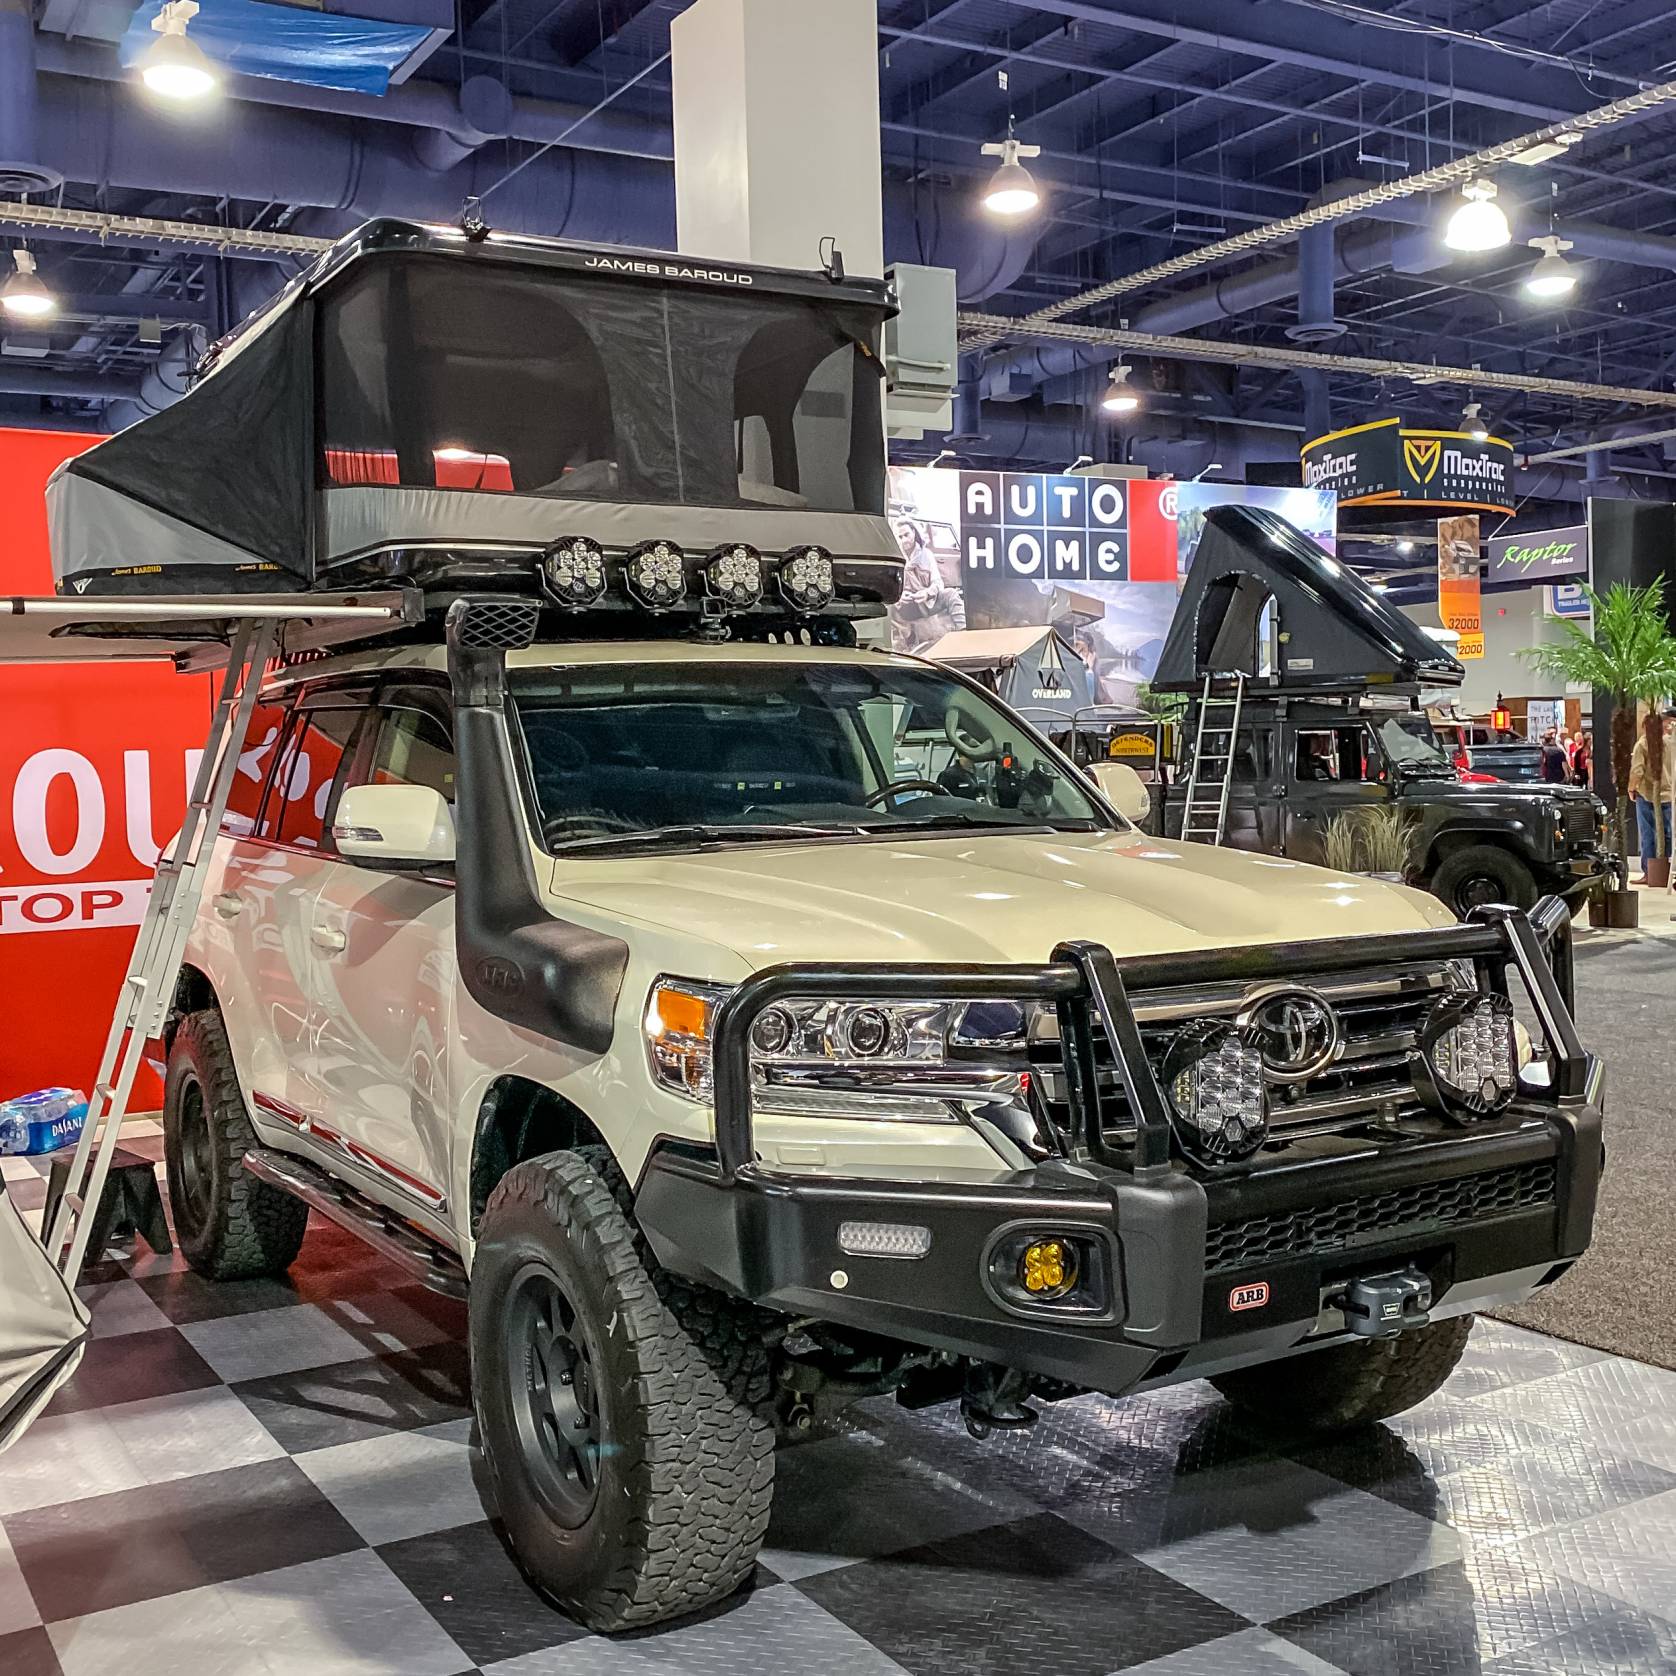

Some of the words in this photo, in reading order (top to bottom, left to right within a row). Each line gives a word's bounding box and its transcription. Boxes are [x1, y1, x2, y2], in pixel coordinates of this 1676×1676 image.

[585, 258, 660, 274] JAMES
[665, 266, 753, 285] BAROUD
[1305, 453, 1357, 487] MaxTrac
[1443, 450, 1505, 481] MaxTrac
[966, 482, 1124, 524] AUTO
[1341, 483, 1384, 499] LOWER
[1441, 491, 1479, 501] LEVEL
[968, 533, 1121, 575] HOME
[1496, 541, 1577, 573] Raptor
[1448, 617, 1480, 630] 32000
[1031, 688, 1072, 699] OVERLAND
[0, 748, 205, 875] OU
[52, 1116, 83, 1137] DASANI
[1236, 1288, 1265, 1305] ARB
